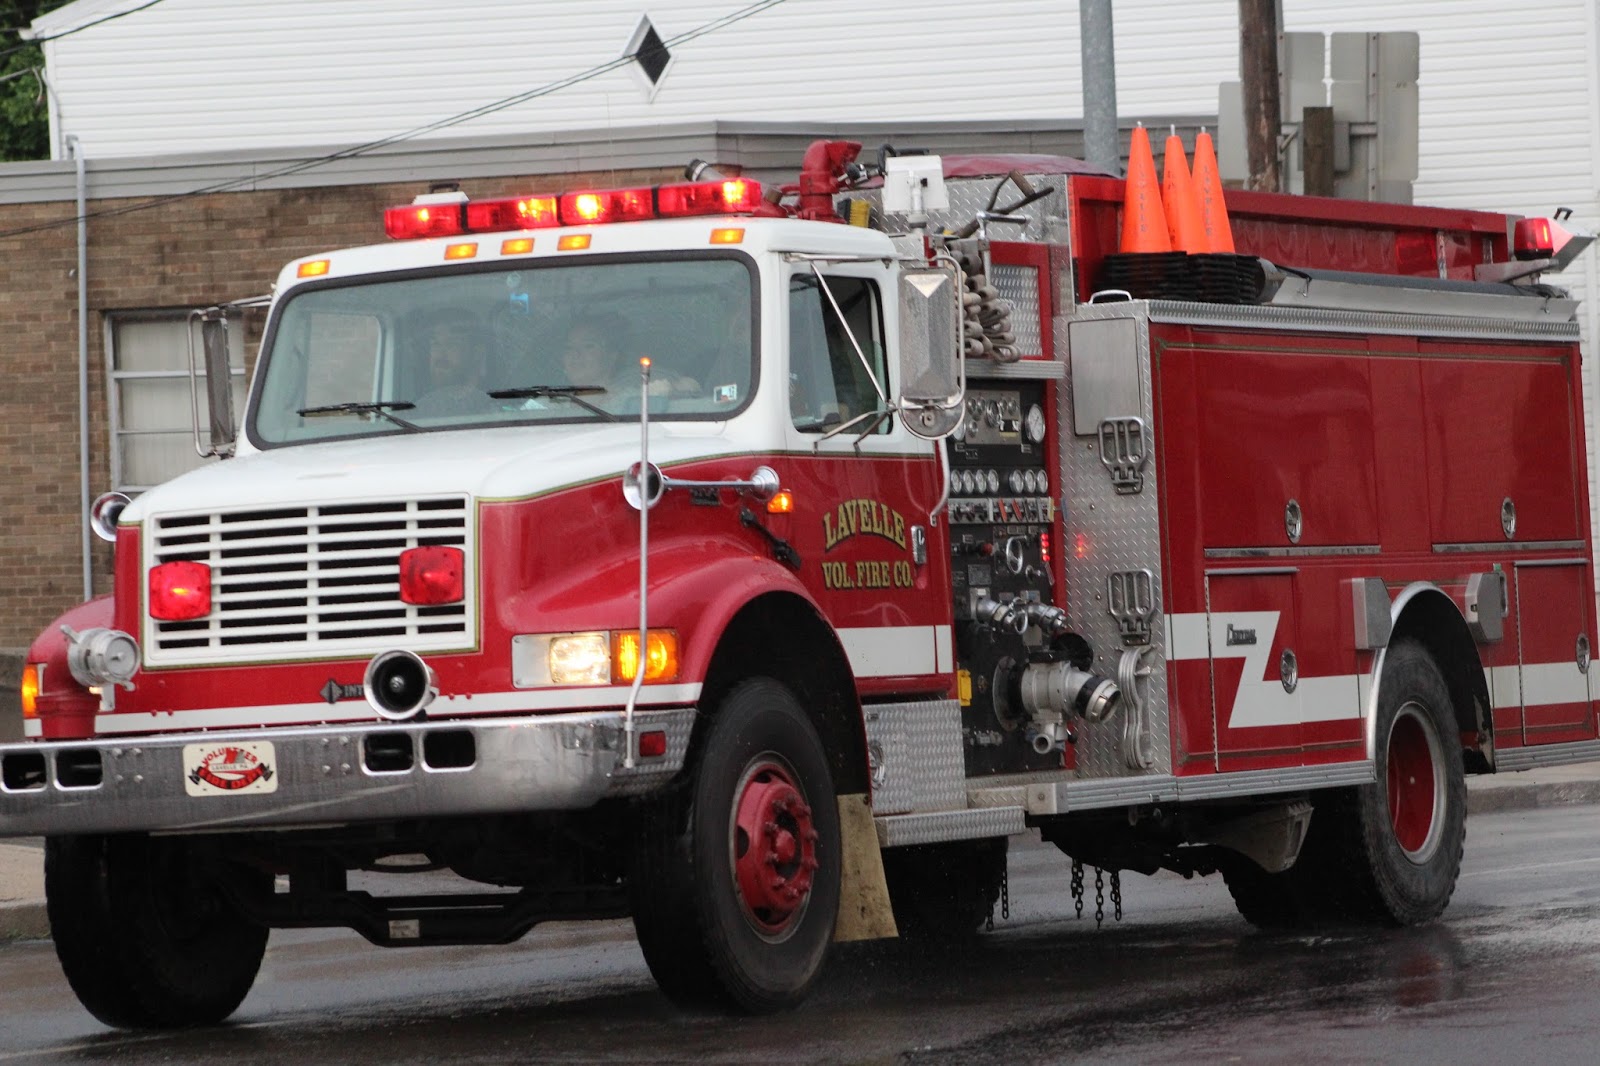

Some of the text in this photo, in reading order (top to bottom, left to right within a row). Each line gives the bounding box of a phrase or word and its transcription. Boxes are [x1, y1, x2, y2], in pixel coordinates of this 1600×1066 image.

[823, 498, 907, 552] LAVELLE
[821, 560, 914, 589] VOL. FIRE CO.
